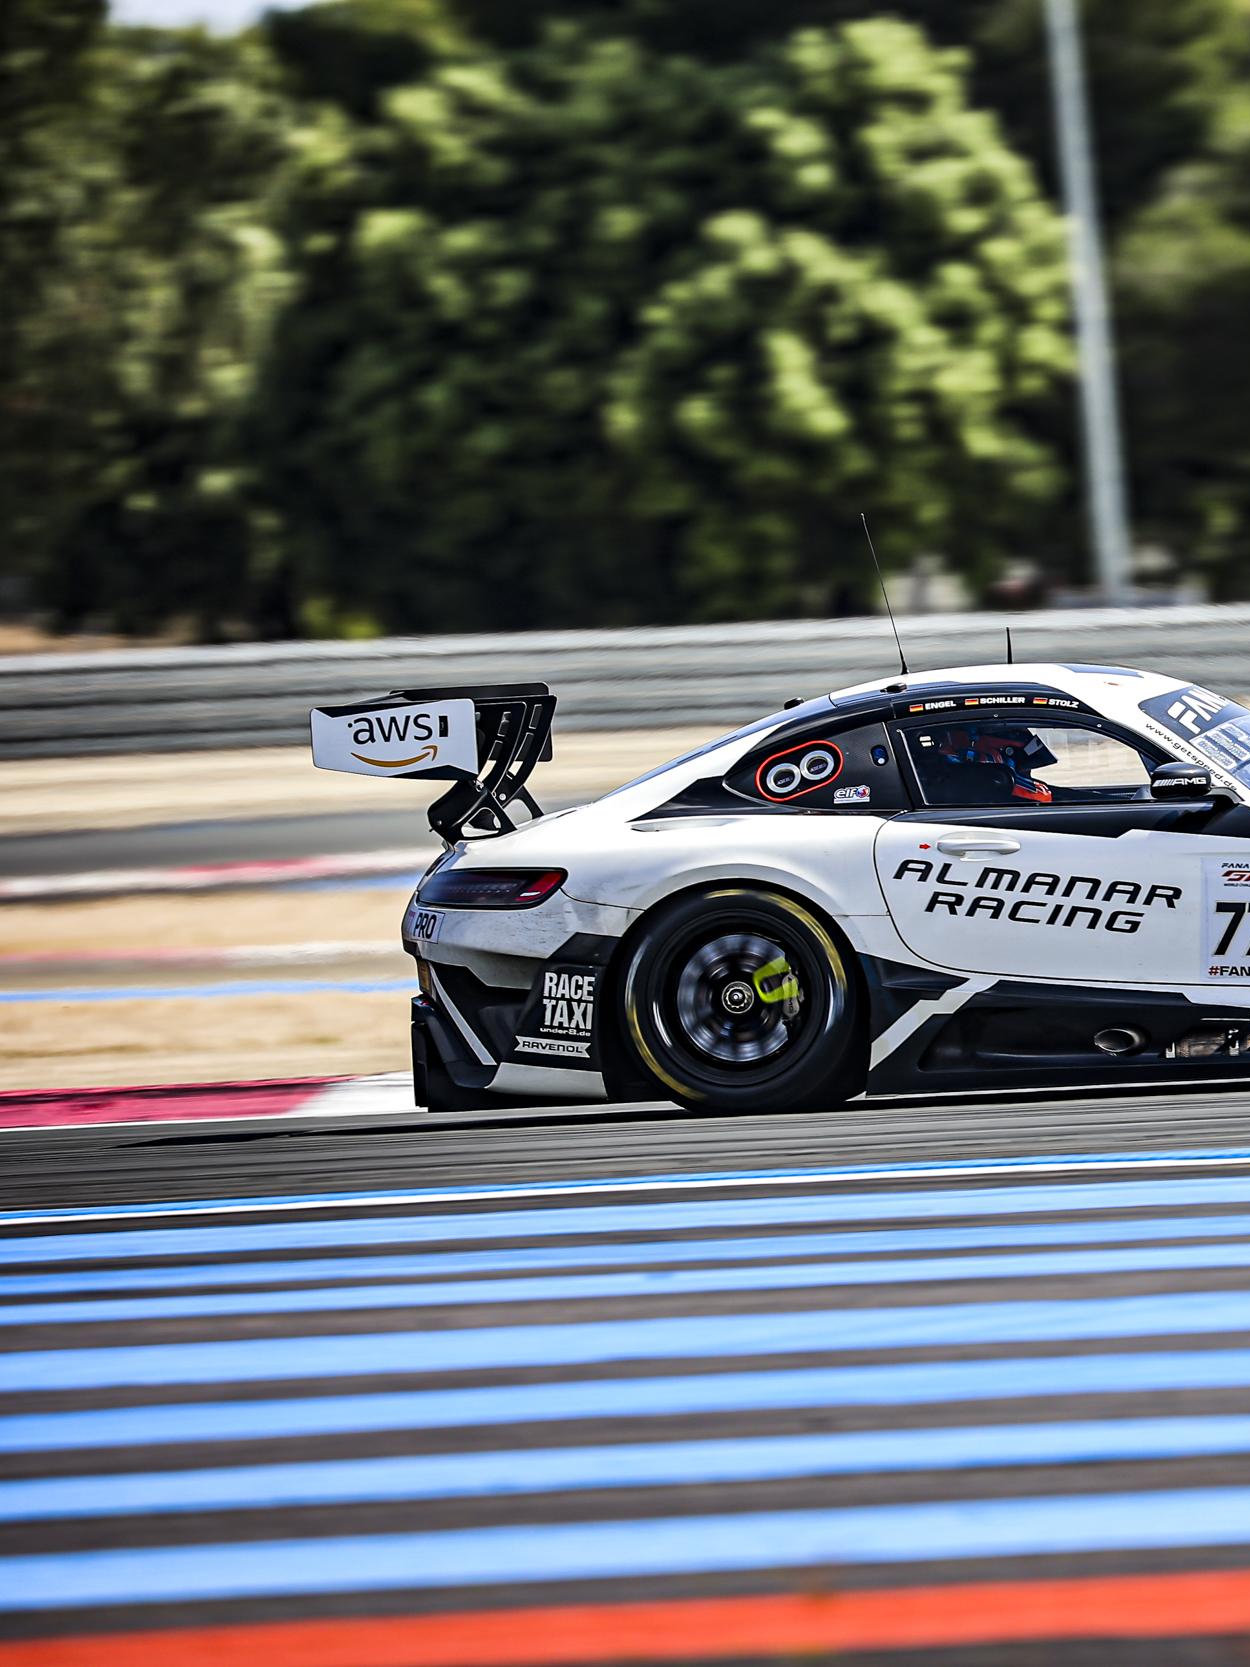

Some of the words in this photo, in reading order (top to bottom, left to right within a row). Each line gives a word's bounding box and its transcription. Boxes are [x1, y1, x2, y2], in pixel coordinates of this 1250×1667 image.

[925, 700, 956, 710] ENGEL
[979, 696, 1025, 704] SCHILLER
[1048, 699, 1079, 708] STOLZ
[353, 713, 433, 745] aws
[1173, 777, 1207, 786] AMG
[836, 788, 857, 799] elf
[892, 858, 1183, 909] ALMANAR
[924, 890, 1145, 934] RACING
[412, 912, 437, 939] PRO
[543, 972, 596, 1001] RACE
[542, 998, 594, 1030] TAXI
[539, 1027, 591, 1037] under8.de
[522, 1041, 583, 1053] RAVENOL
